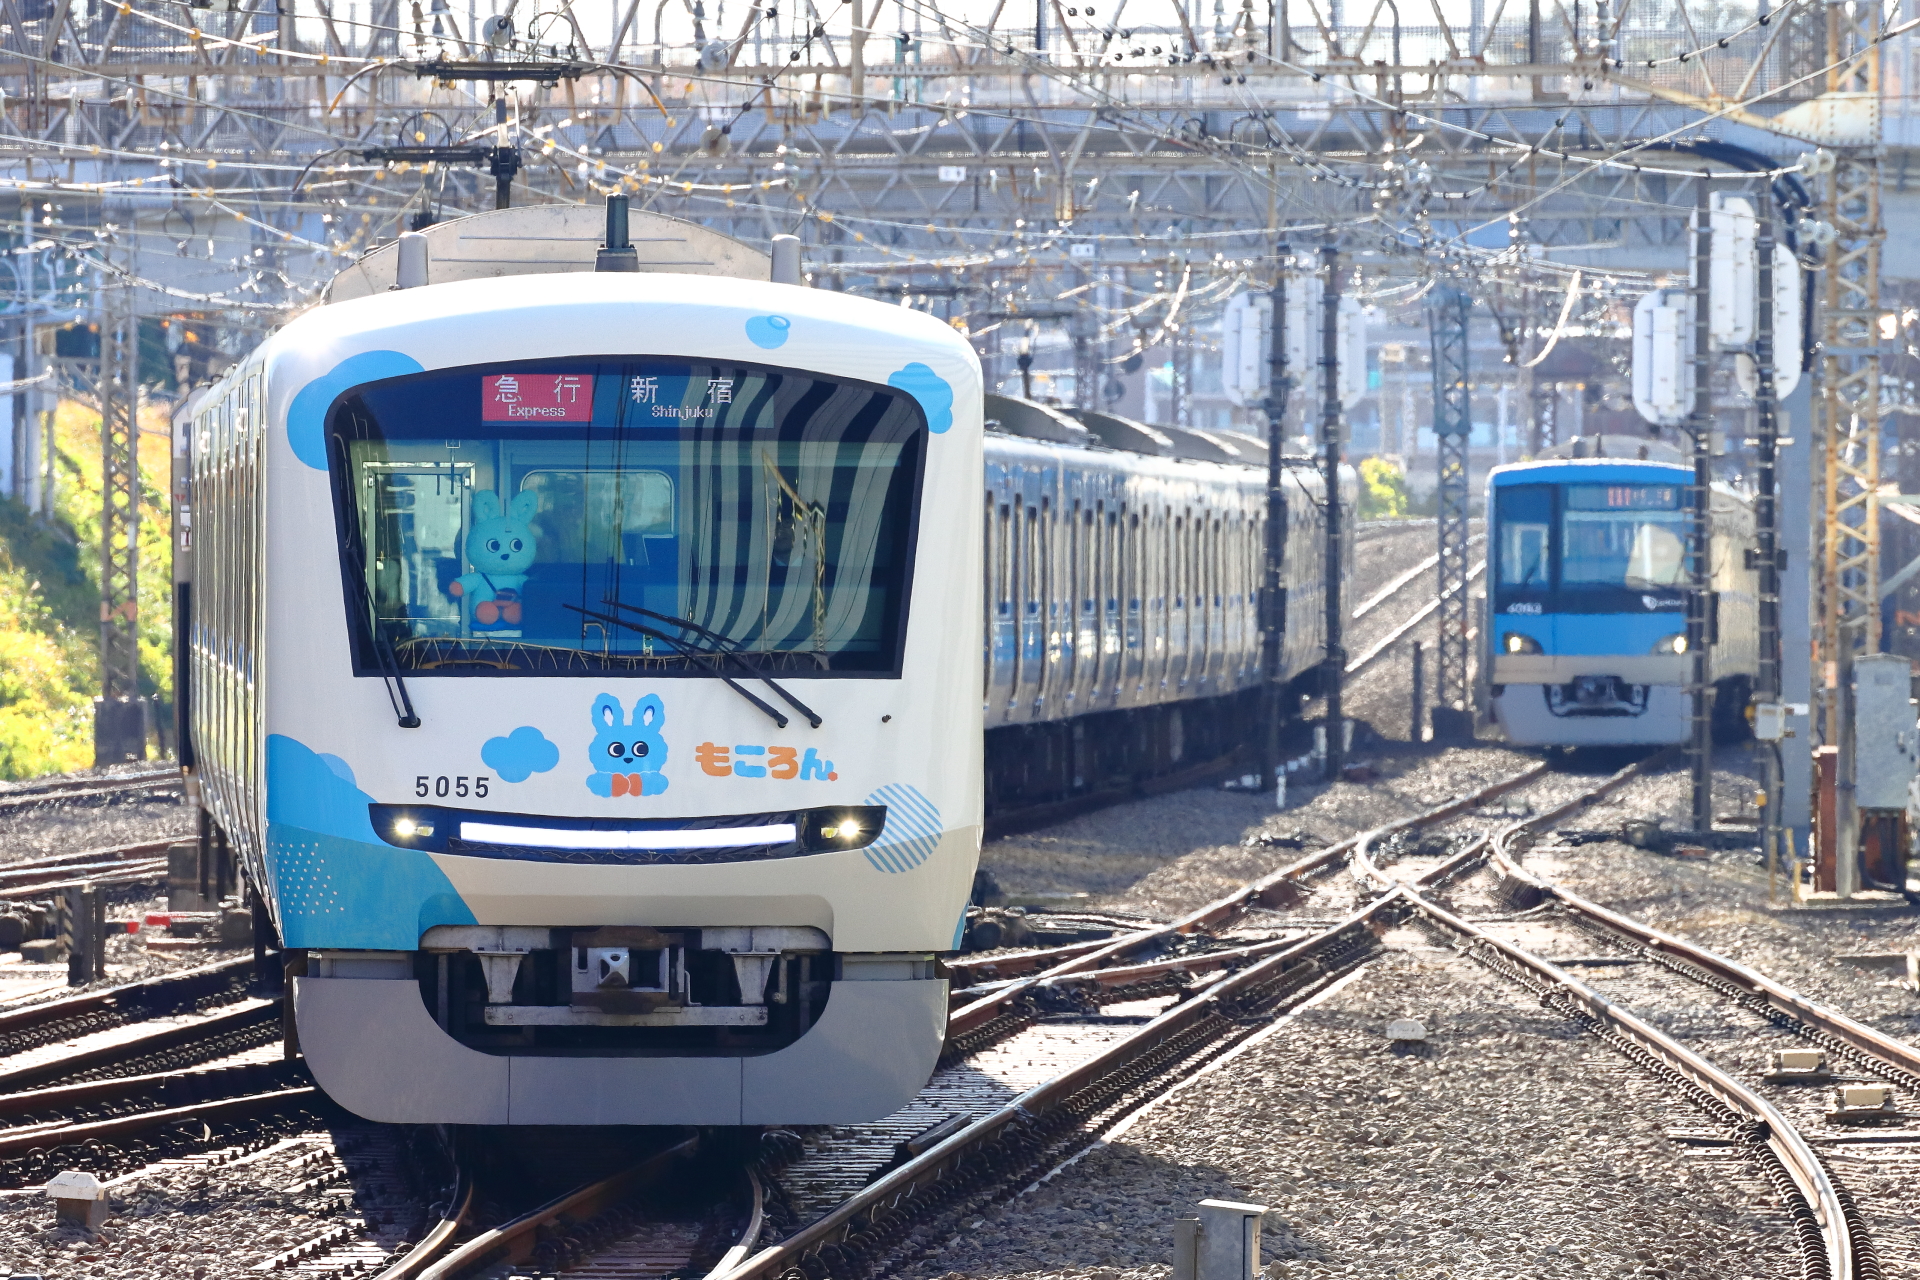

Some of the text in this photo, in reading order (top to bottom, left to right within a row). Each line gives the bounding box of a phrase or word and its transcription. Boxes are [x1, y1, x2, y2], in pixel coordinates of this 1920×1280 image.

[495, 375, 581, 403] 急行
[631, 376, 734, 404] 新宿
[508, 404, 566, 419] Express
[652, 405, 713, 421] Shinjuku
[695, 741, 838, 782] もころん
[415, 775, 490, 798] 5055
